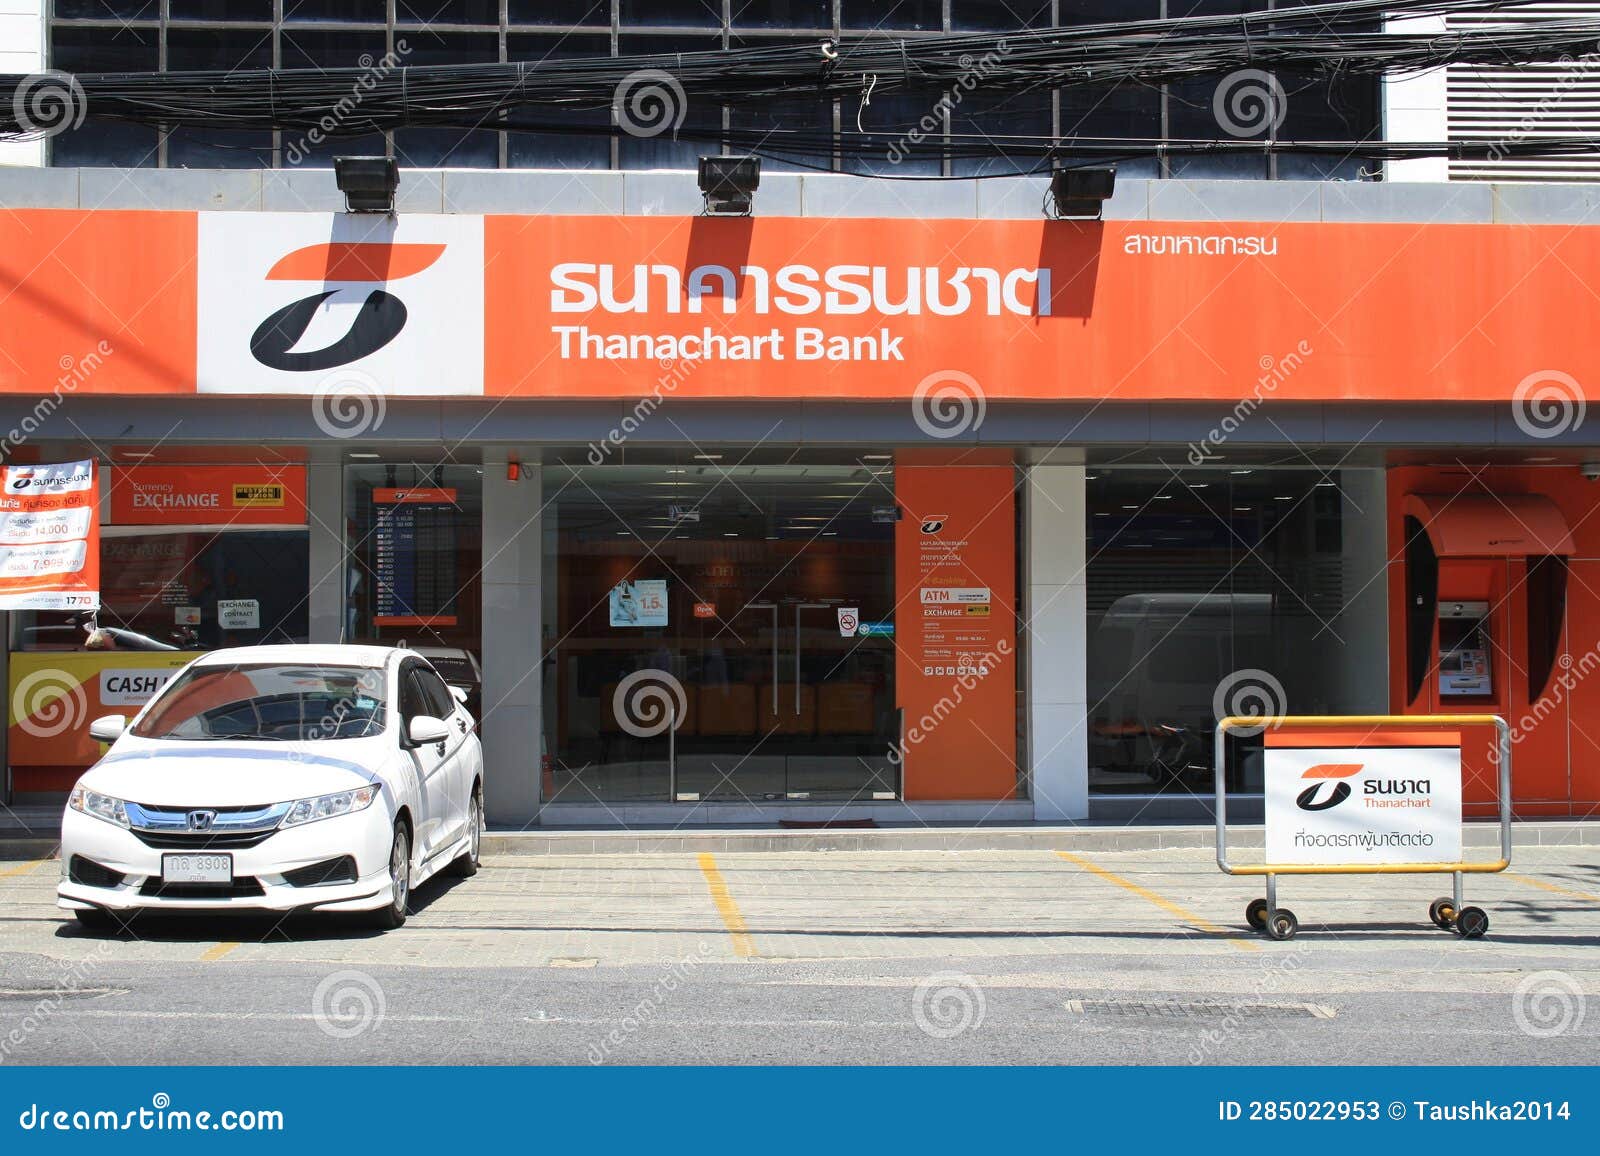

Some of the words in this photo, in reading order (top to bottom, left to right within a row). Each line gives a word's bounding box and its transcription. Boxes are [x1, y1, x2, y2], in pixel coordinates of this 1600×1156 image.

[1124, 234, 1277, 255] สาขาหาดกะรน
[550, 263, 1052, 317] ธนาคารธนชาต
[552, 326, 784, 360] Thanachart
[795, 328, 905, 361] Bank
[133, 482, 174, 492] Currency
[133, 493, 220, 507] EXCHANGE
[66, 596, 92, 605] 1770
[924, 591, 950, 601] ATM
[106, 677, 157, 693] CASH
[1363, 779, 1431, 794] ธนชาต
[1363, 797, 1431, 808] Thanachart
[1294, 827, 1434, 851] ที่จอดรถผู้มาติดต่อ
[197, 857, 229, 871] 8908
